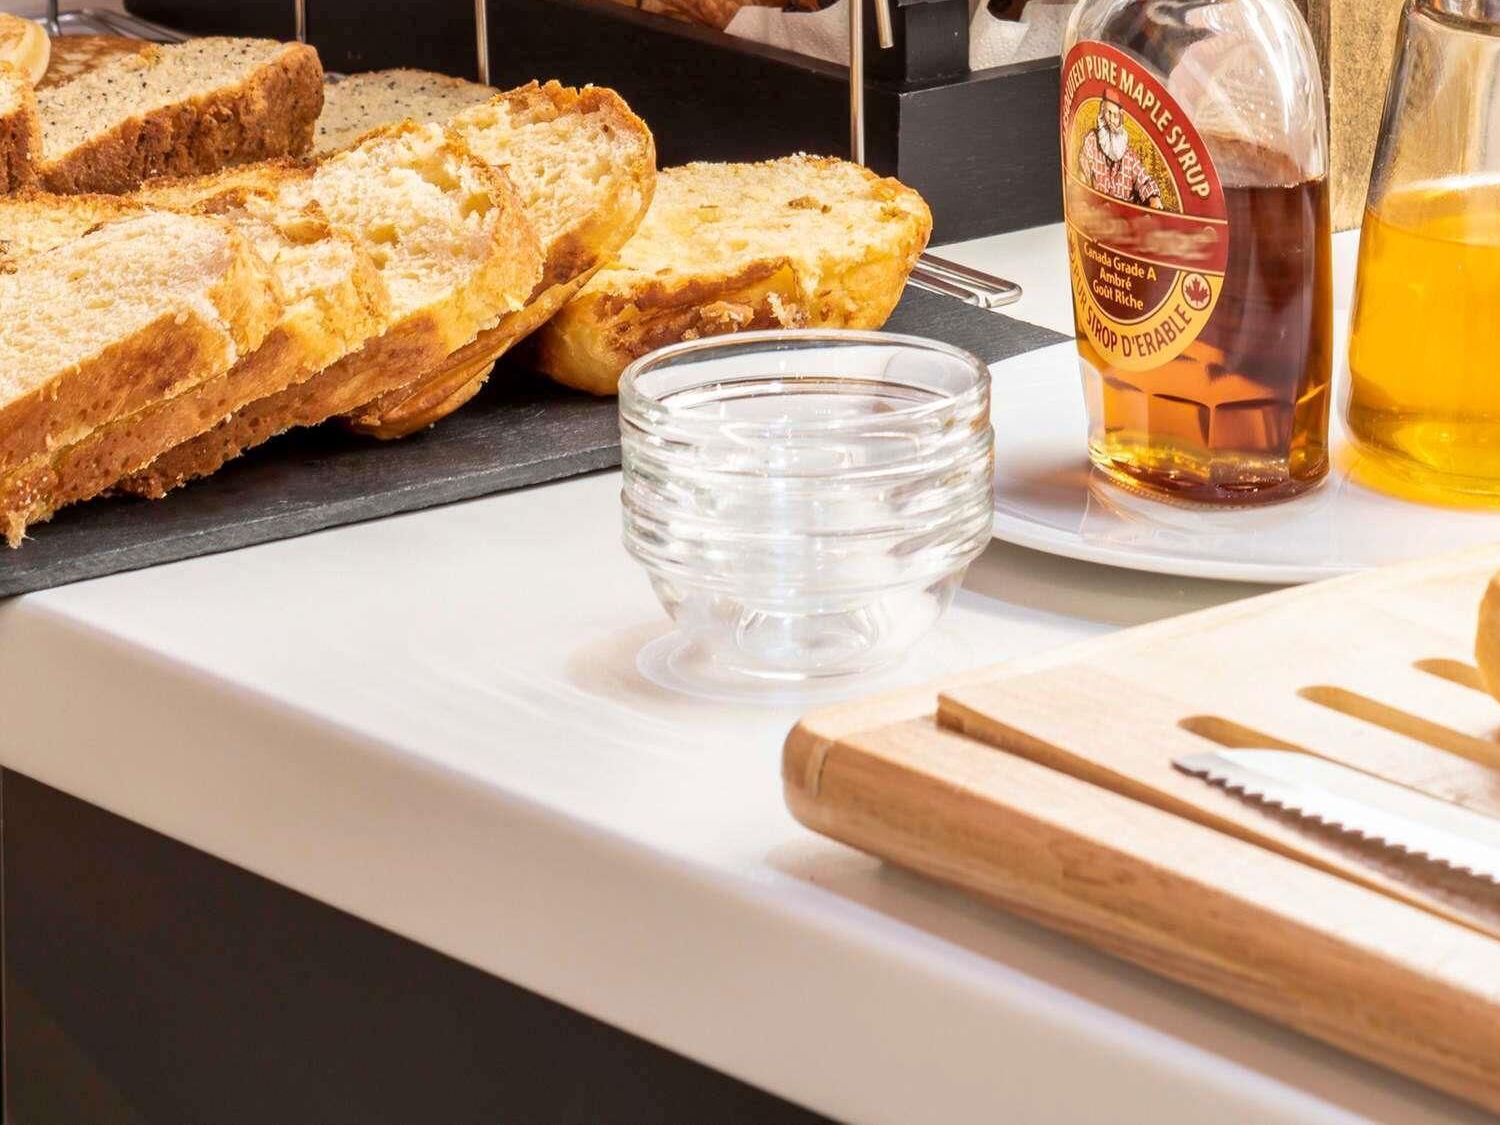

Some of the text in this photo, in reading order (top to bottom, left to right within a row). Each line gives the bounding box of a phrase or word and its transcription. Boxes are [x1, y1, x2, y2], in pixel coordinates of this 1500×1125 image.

[1085, 55, 1117, 86] PURE
[1119, 68, 1174, 132] MAPLE
[1166, 126, 1210, 198] SYRUP
[1083, 242, 1112, 268] Canada
[1113, 256, 1144, 278] Grade
[1147, 266, 1157, 281] A
[1100, 266, 1132, 291] Ambré
[1093, 279, 1144, 311] Goût Riche
[1087, 306, 1117, 352] SIROP
[1121, 304, 1192, 357] D'ERABLE
